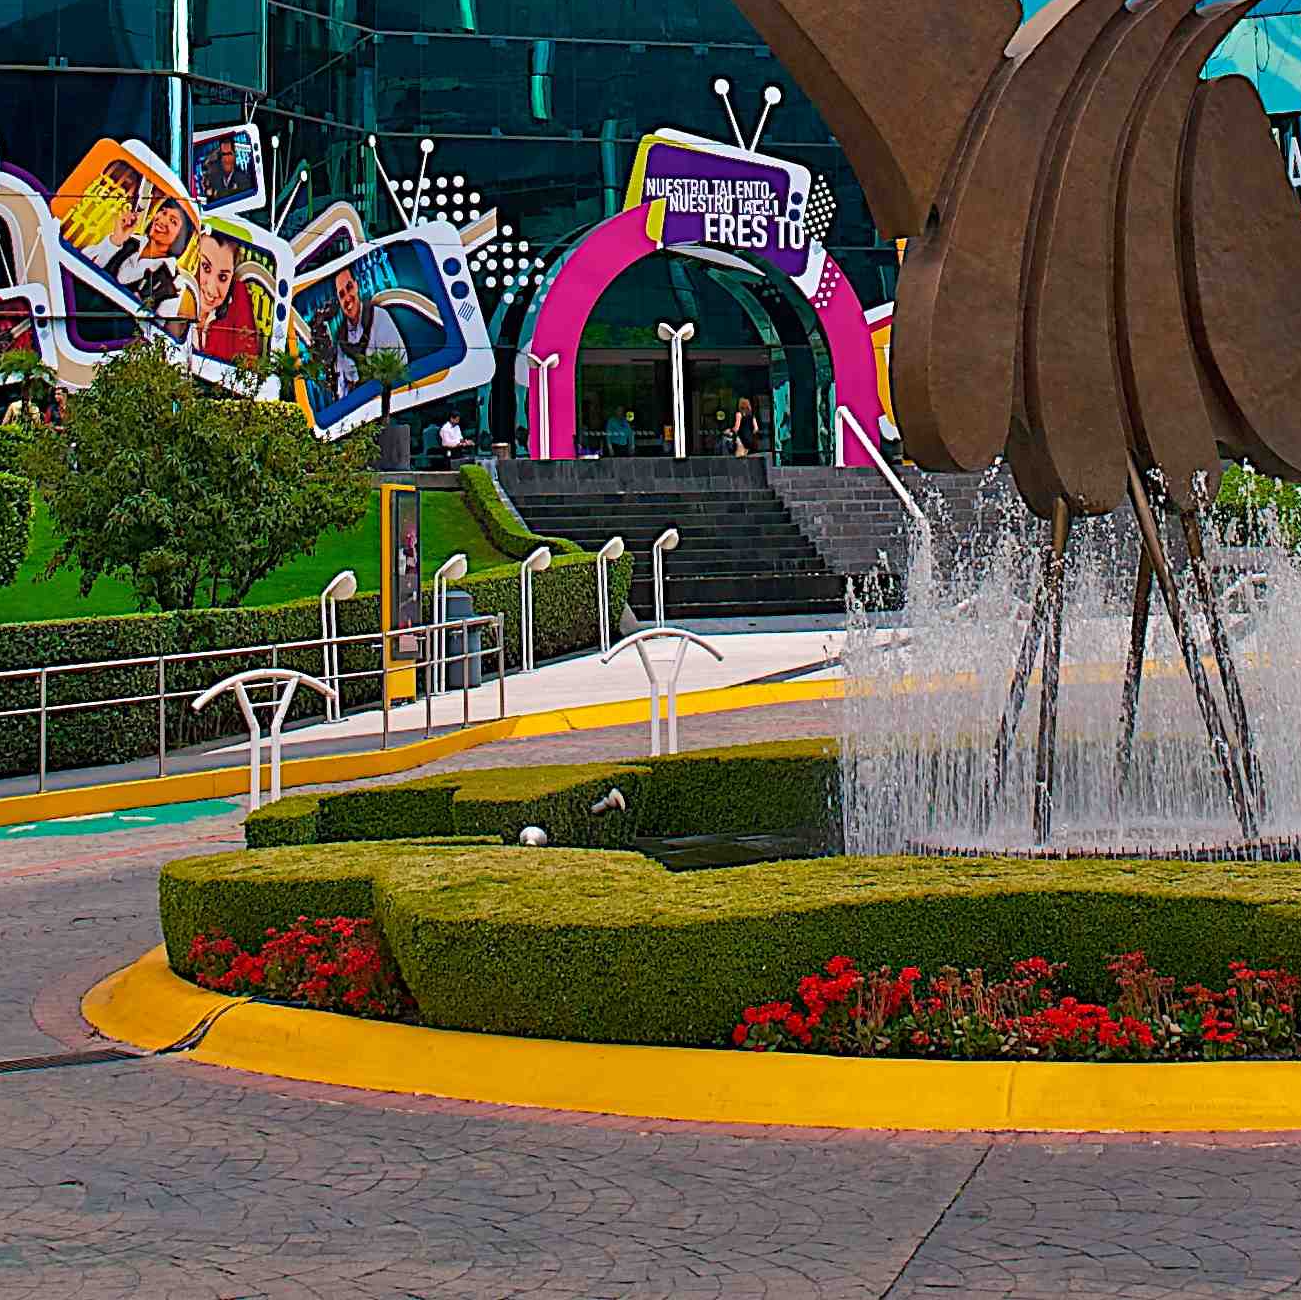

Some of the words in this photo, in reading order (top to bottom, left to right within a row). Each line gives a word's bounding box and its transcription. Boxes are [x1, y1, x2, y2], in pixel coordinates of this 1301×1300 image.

[646, 177, 709, 198] NUESTRO
[669, 195, 734, 214] NUESTRO
[704, 213, 768, 249] ERES
